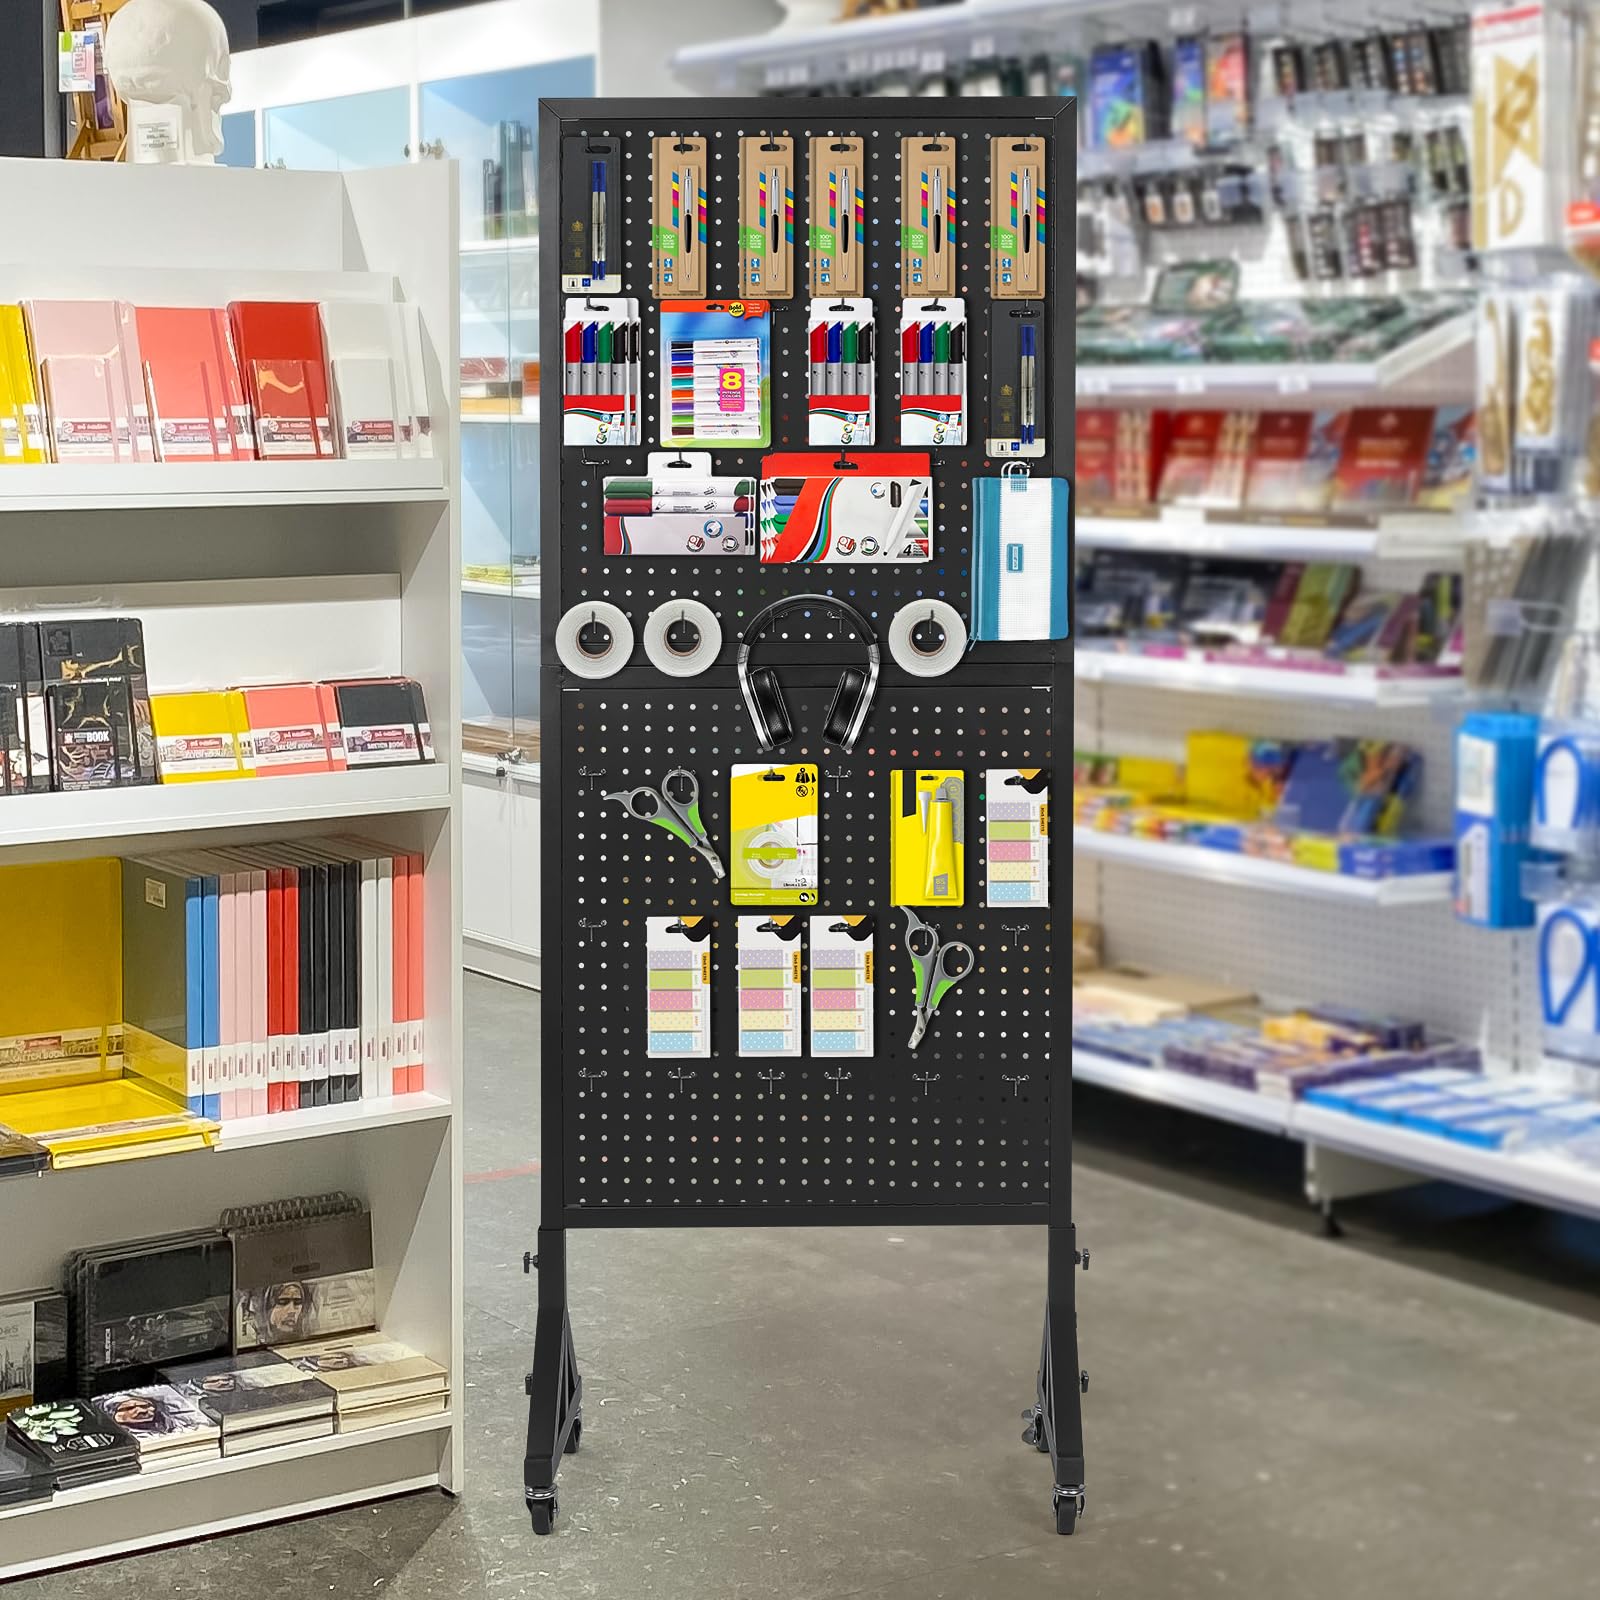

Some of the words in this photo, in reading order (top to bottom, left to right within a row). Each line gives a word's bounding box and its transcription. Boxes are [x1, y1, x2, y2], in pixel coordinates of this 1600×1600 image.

[722, 371, 743, 391] 8
[903, 544, 912, 556] 4
[86, 731, 110, 742] BOOK
